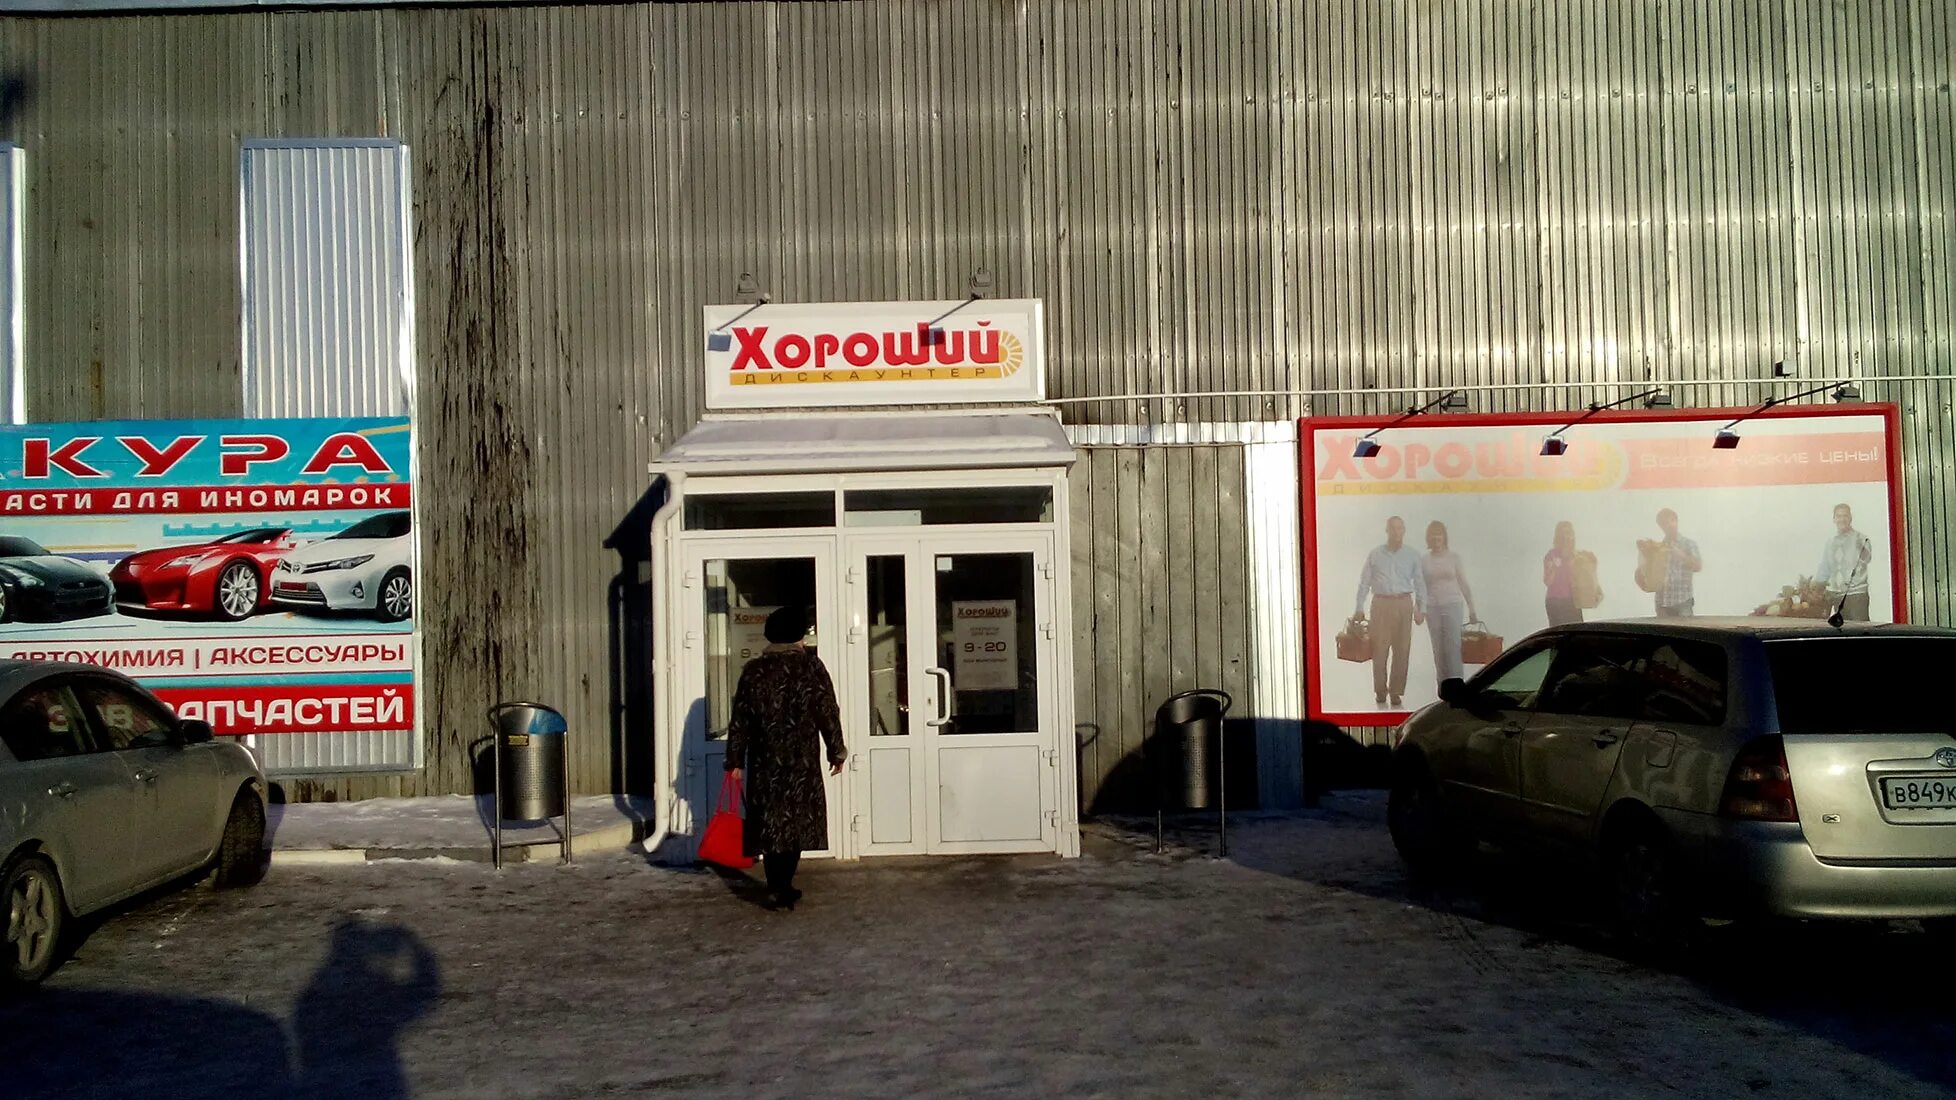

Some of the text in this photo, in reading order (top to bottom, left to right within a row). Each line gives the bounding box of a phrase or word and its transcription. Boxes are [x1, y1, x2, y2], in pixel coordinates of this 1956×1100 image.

[731, 320, 1000, 370] Хороший
[744, 367, 986, 385] ДИСКАУНТЕР
[0, 432, 394, 480] КУРА
[112, 491, 179, 508] ДЛЯ
[200, 487, 392, 507] ИНОМАРОК
[210, 643, 404, 665] АКСЕССУАРЫ
[165, 688, 404, 727] АПЧАСТЕЙ
